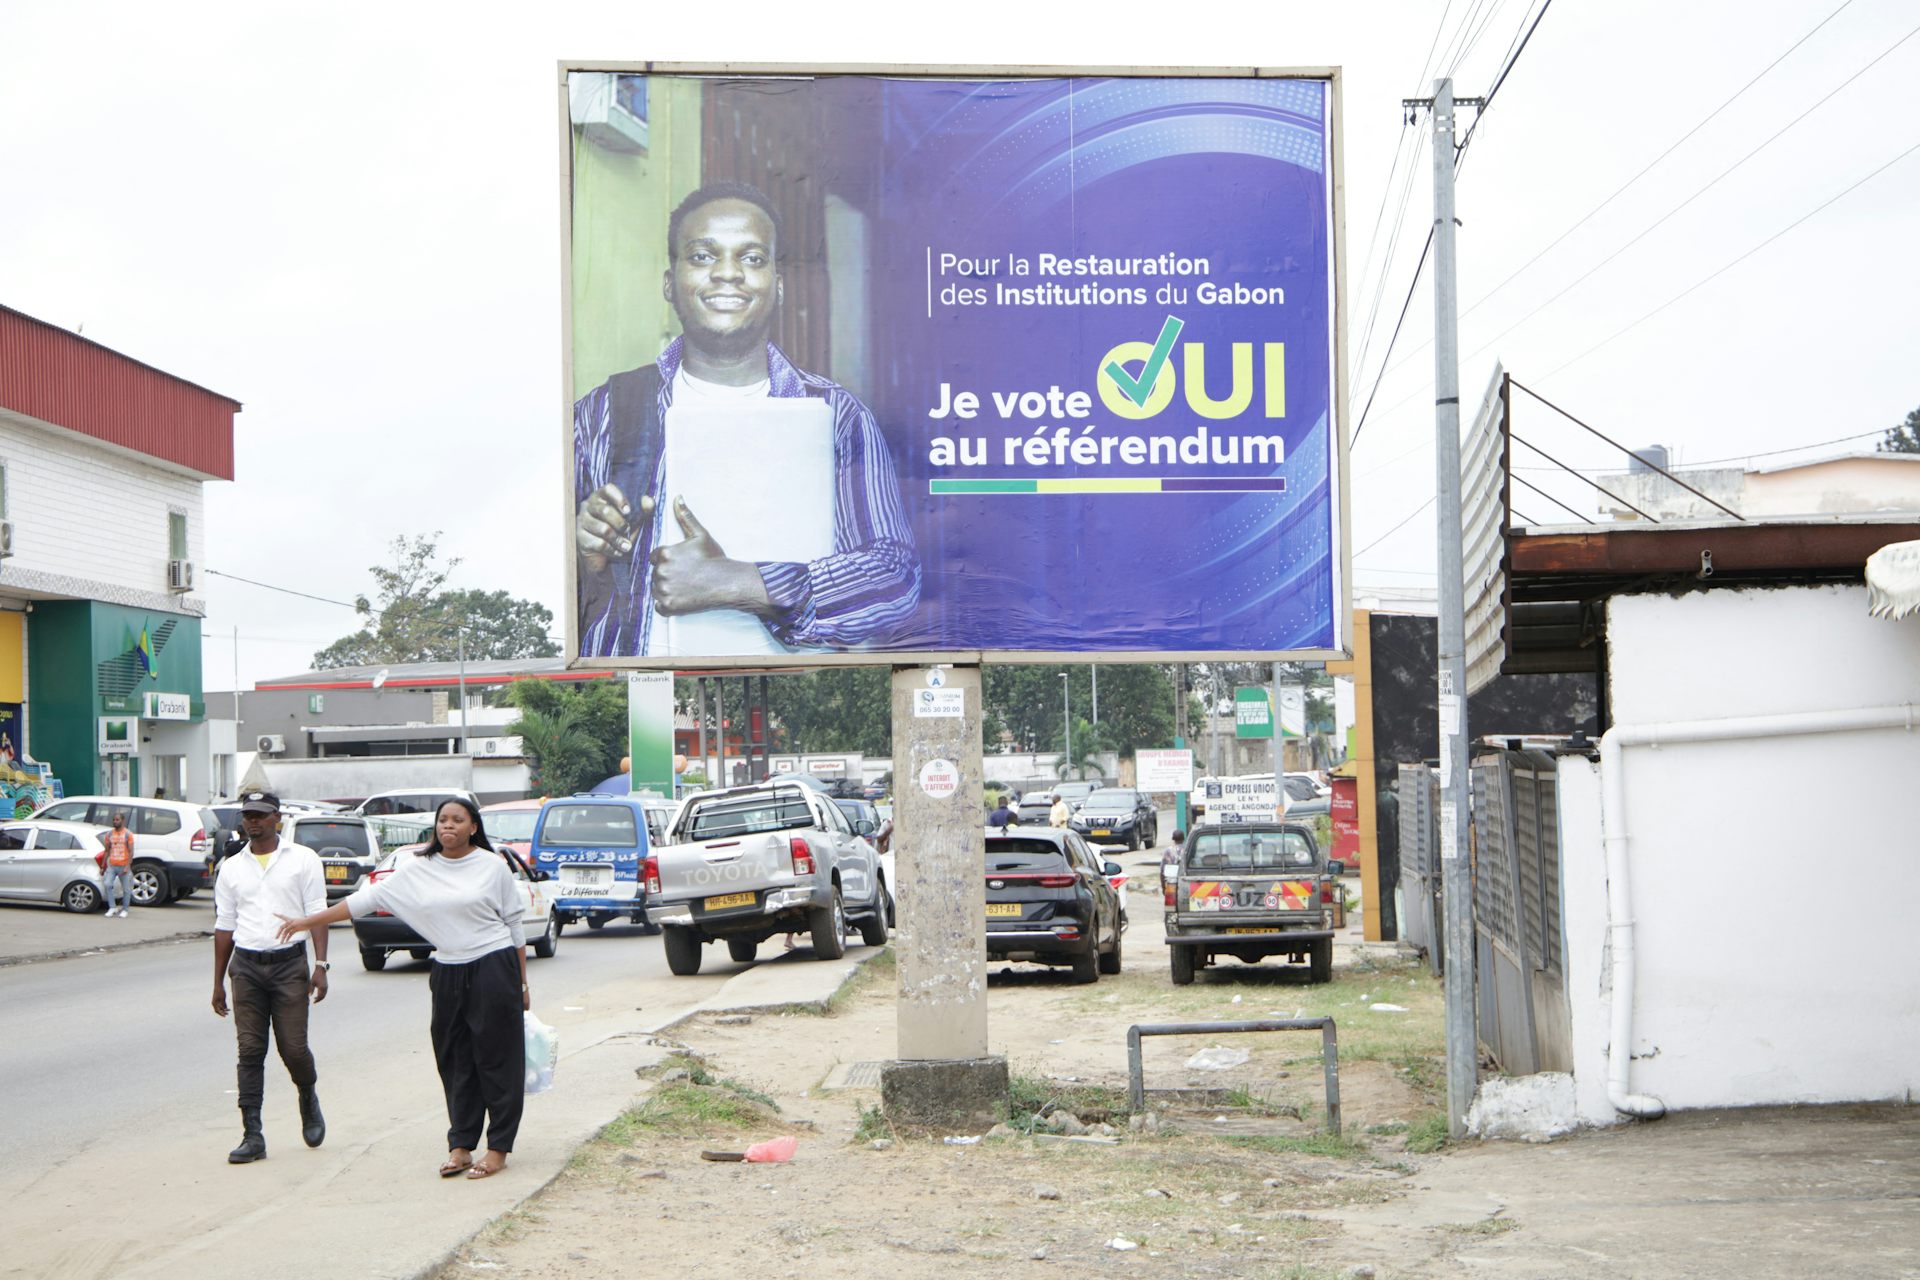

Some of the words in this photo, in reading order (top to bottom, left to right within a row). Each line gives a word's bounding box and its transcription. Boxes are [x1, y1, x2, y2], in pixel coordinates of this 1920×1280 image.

[940, 253, 1000, 276] Pour
[1009, 253, 1030, 276] la
[1038, 252, 1210, 276] Restauration
[940, 283, 988, 306] des
[996, 282, 1147, 306] Institutions
[1155, 282, 1188, 305] du
[1196, 282, 1285, 305] Gabon
[928, 382, 980, 419] Je
[992, 385, 1092, 419] vote
[1096, 341, 1286, 420] OUI
[928, 435, 987, 466] au
[1003, 425, 1285, 465] référendum
[631, 675, 671, 683] Orabank
[932, 677, 940, 686] A
[160, 700, 187, 714] Orabank
[927, 774, 951, 783] INTERDIT
[1225, 783, 1252, 794] EXPRESS
[1253, 783, 1276, 793] UNION
[597, 850, 639, 862] Bus
[680, 860, 770, 887] TOYOTA
[1267, 896, 1276, 905] 90
